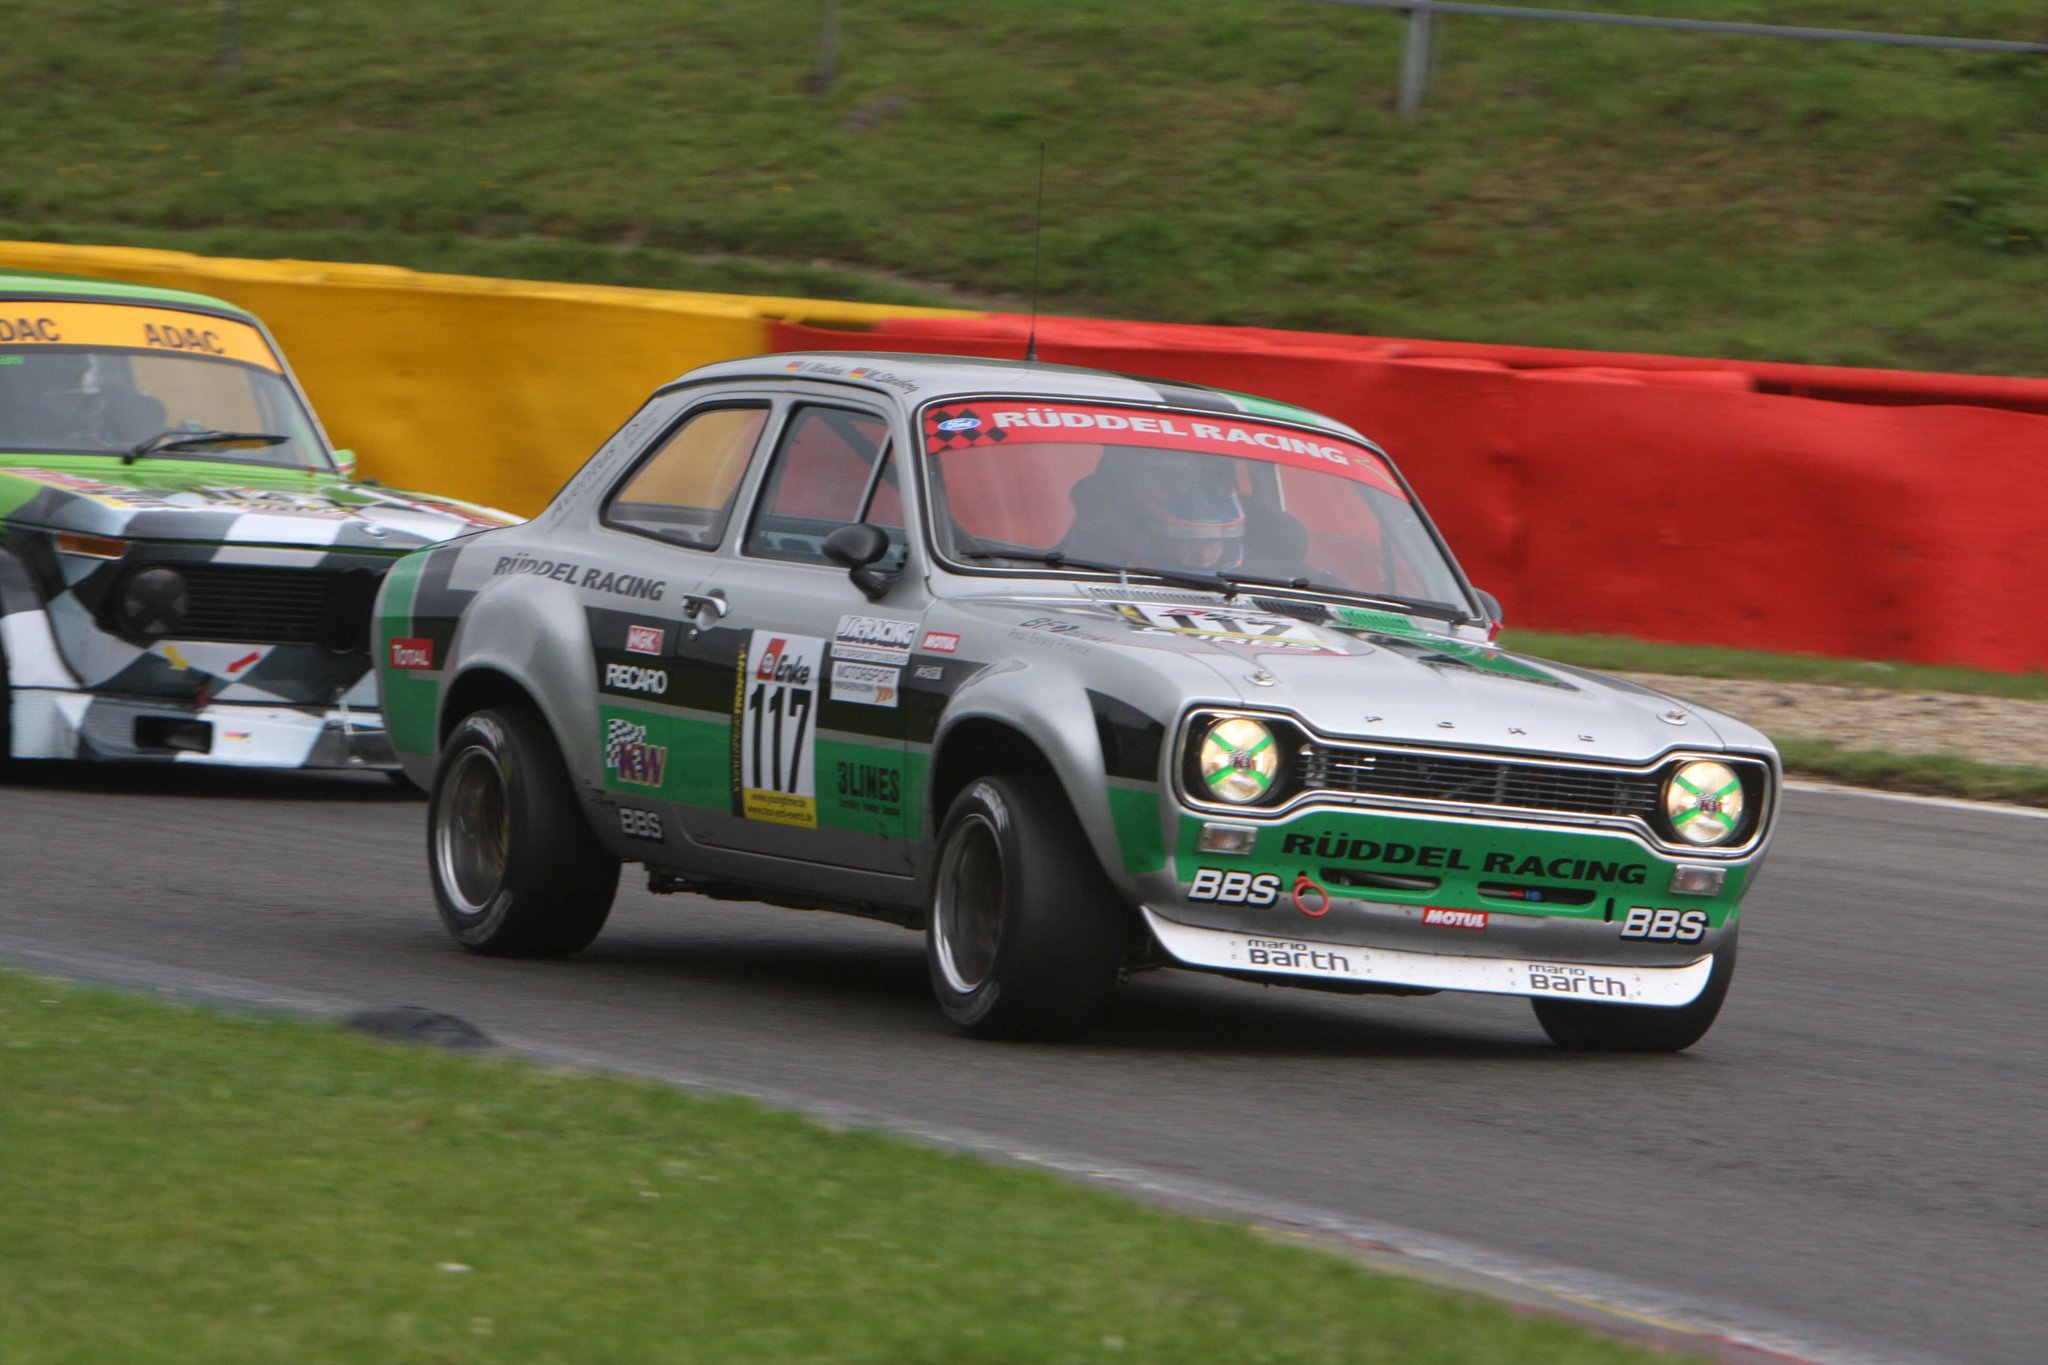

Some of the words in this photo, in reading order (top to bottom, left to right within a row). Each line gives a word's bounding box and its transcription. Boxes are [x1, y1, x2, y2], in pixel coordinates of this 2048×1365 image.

[0, 317, 62, 342] DAC
[143, 323, 225, 355] ADAC
[992, 408, 1188, 436] RÜDDEL
[1191, 422, 1350, 466] RACING
[492, 552, 578, 585] RÜDDEL
[581, 566, 666, 602] RACING
[605, 663, 668, 694] RECARO
[748, 683, 813, 794] 117
[620, 807, 662, 839] BBS
[1282, 831, 1471, 871] RÜDDEL
[1482, 851, 1648, 885] RACING
[1188, 867, 1281, 906] BBS
[1424, 910, 1486, 928] MOTUL
[1620, 907, 1708, 942] BBS
[1248, 939, 1308, 951] mario
[1249, 949, 1351, 972] Barth
[1528, 963, 1586, 976] mario
[1530, 974, 1627, 998] Barth
